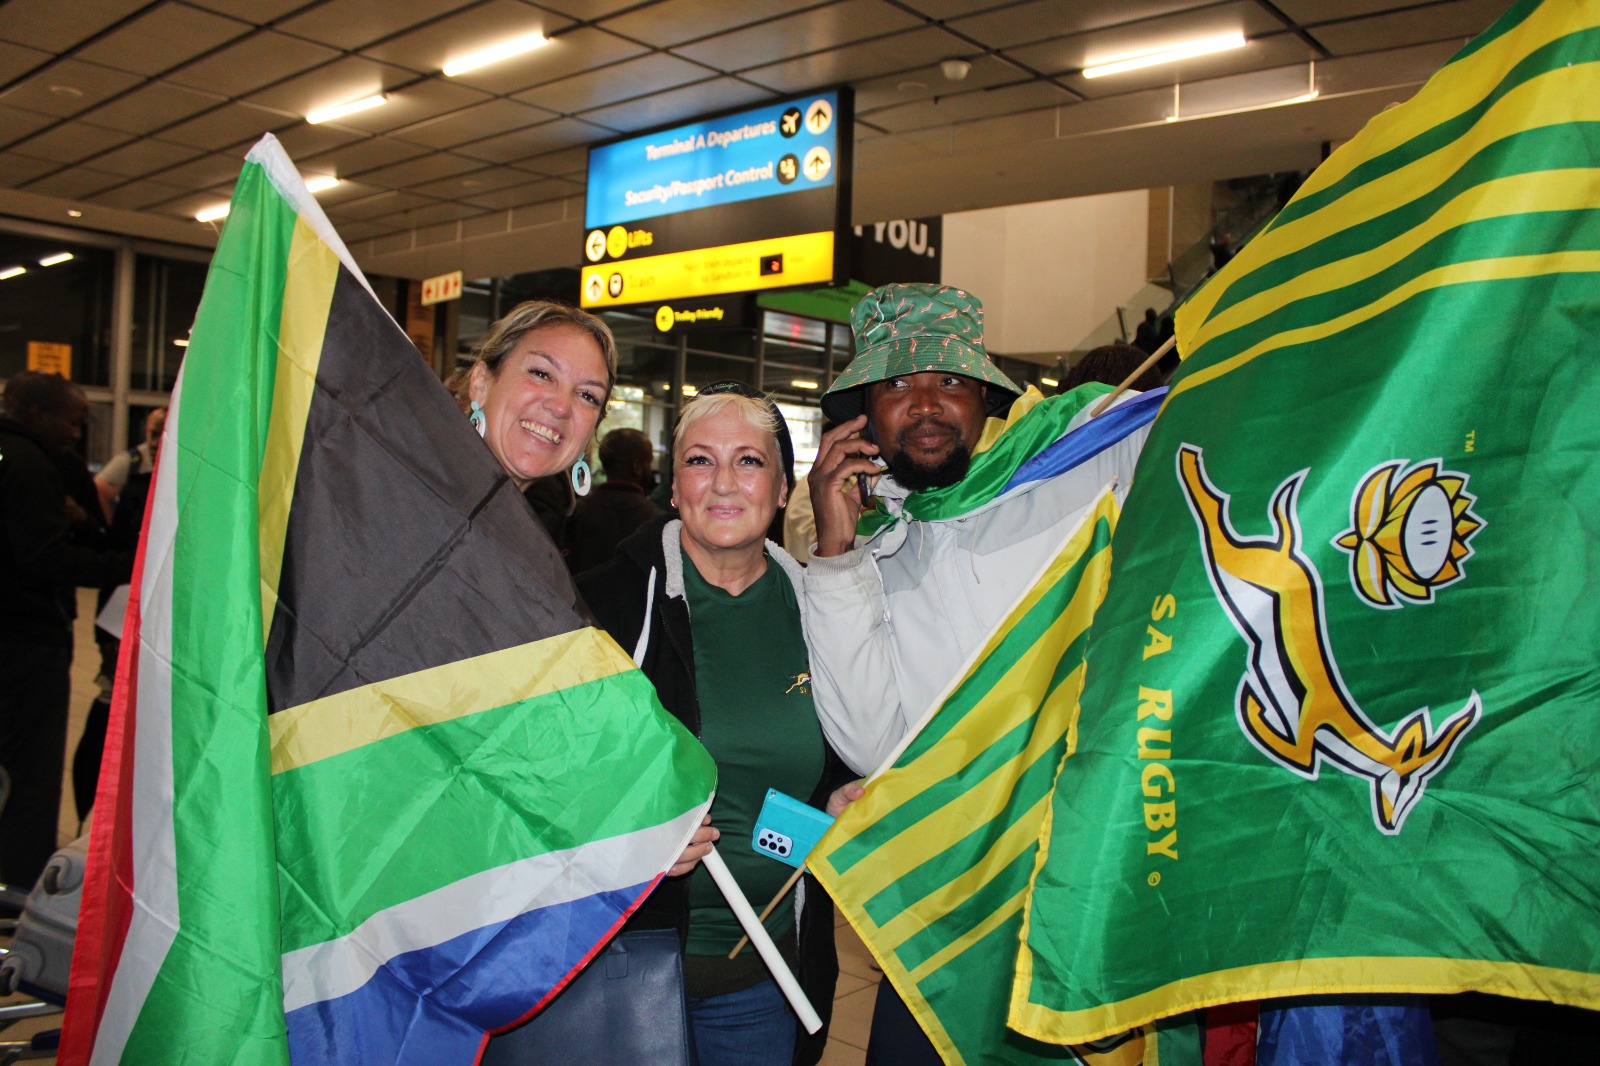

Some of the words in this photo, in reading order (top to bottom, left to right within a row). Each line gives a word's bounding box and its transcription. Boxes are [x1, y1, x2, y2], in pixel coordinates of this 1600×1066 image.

[645, 134, 695, 160] Terminal
[695, 133, 706, 149] A
[707, 120, 777, 148] Departures
[725, 160, 774, 186] Control
[627, 229, 653, 249] Lifts
[1142, 593, 1177, 661] SA
[1137, 684, 1179, 861] RUGBY
